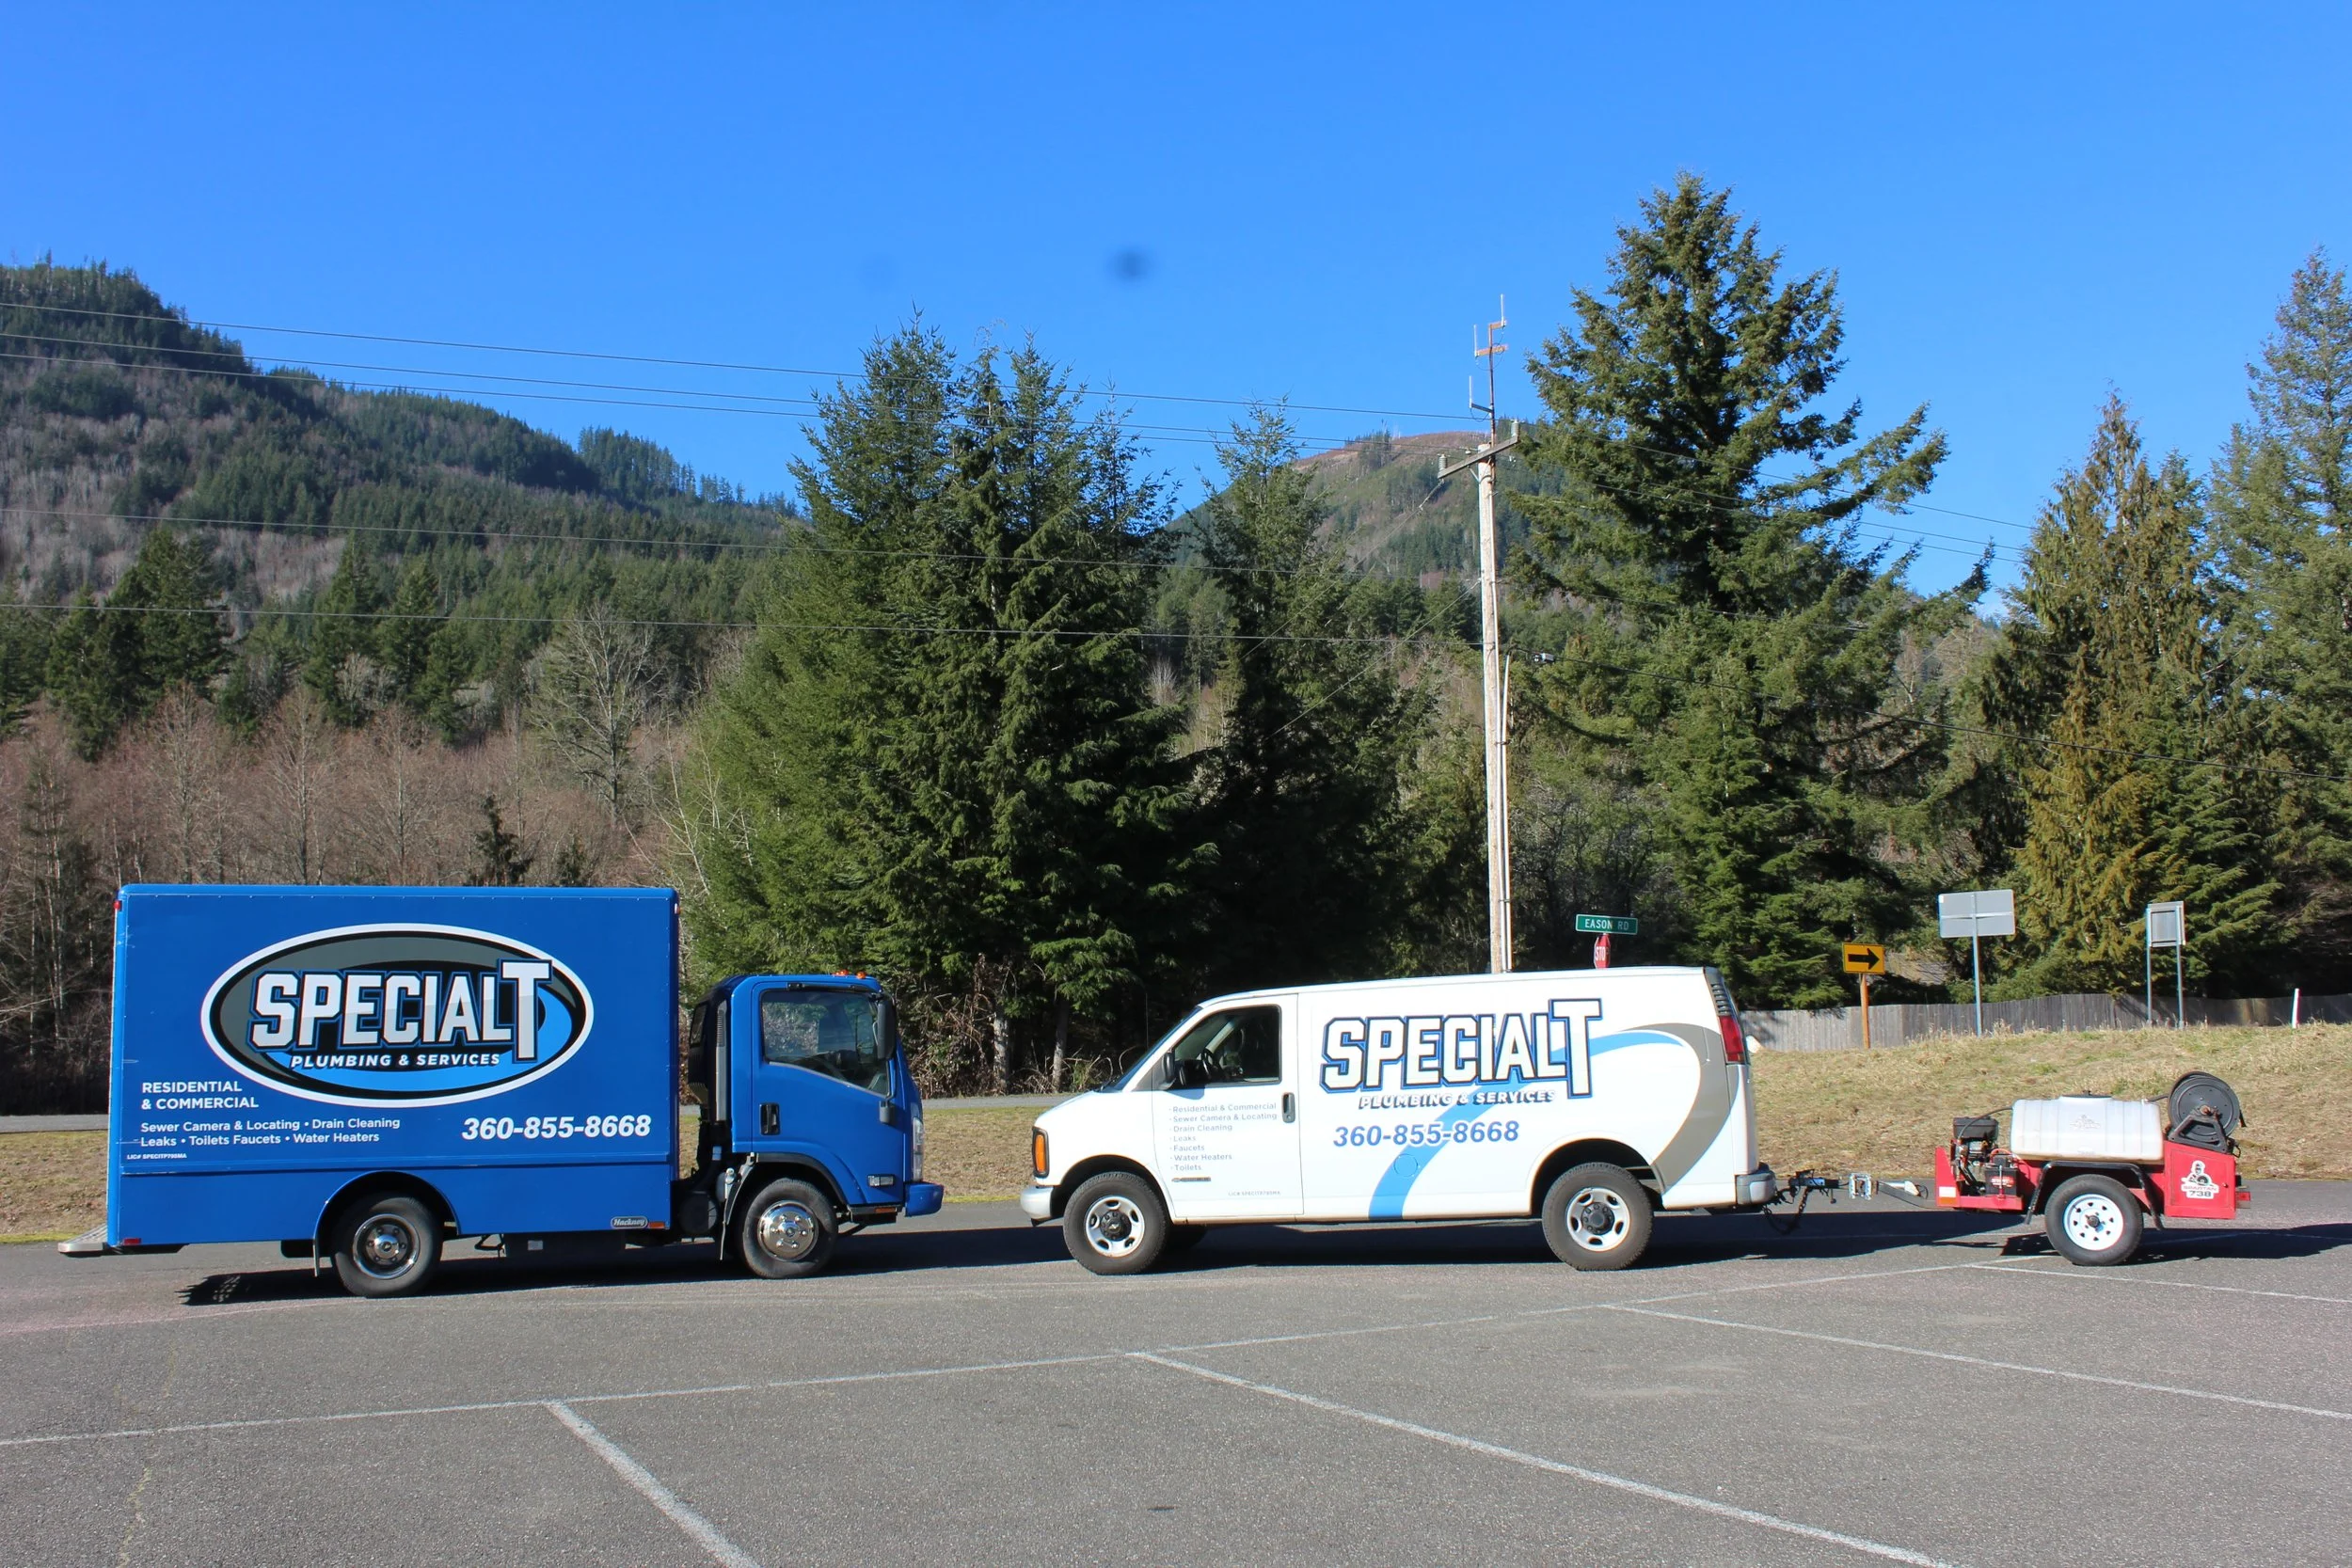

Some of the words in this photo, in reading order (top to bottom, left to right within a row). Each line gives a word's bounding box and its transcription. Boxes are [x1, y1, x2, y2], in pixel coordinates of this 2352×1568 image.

[1584, 918, 1613, 929] EASON
[1618, 921, 1629, 930] RD
[291, 1054, 391, 1069] PLUMBING
[398, 1054, 410, 1067] &
[416, 1053, 501, 1066] SERVICES
[142, 1081, 243, 1094] RESIDENTIAL
[141, 1099, 151, 1110] &
[155, 1097, 260, 1110] COMMERCIAL
[1358, 1092, 1454, 1110] PLUMBING
[1457, 1091, 1469, 1106] &
[1472, 1089, 1556, 1106] SERVICES
[1228, 1102, 1277, 1111] Commercial
[140, 1122, 180, 1132] Sewer
[183, 1120, 230, 1132] Camera
[233, 1120, 243, 1131] &
[246, 1119, 301, 1131] Locating
[312, 1118, 345, 1129] Drain
[347, 1117, 401, 1129] Cleaning
[461, 1114, 653, 1141] 360-855-8668
[1173, 1124, 1195, 1132] Drain
[140, 1136, 177, 1147] Leaks
[189, 1134, 230, 1146] Toilets
[233, 1133, 281, 1145] Faucets
[293, 1132, 331, 1144] Water
[333, 1132, 380, 1143] Heaters
[1333, 1120, 1519, 1147] 360-855-8668
[1174, 1153, 1199, 1162] Water
[1200, 1152, 1232, 1161] Heaters
[1174, 1163, 1202, 1171] Toilets
[612, 1218, 646, 1227] Hackney
